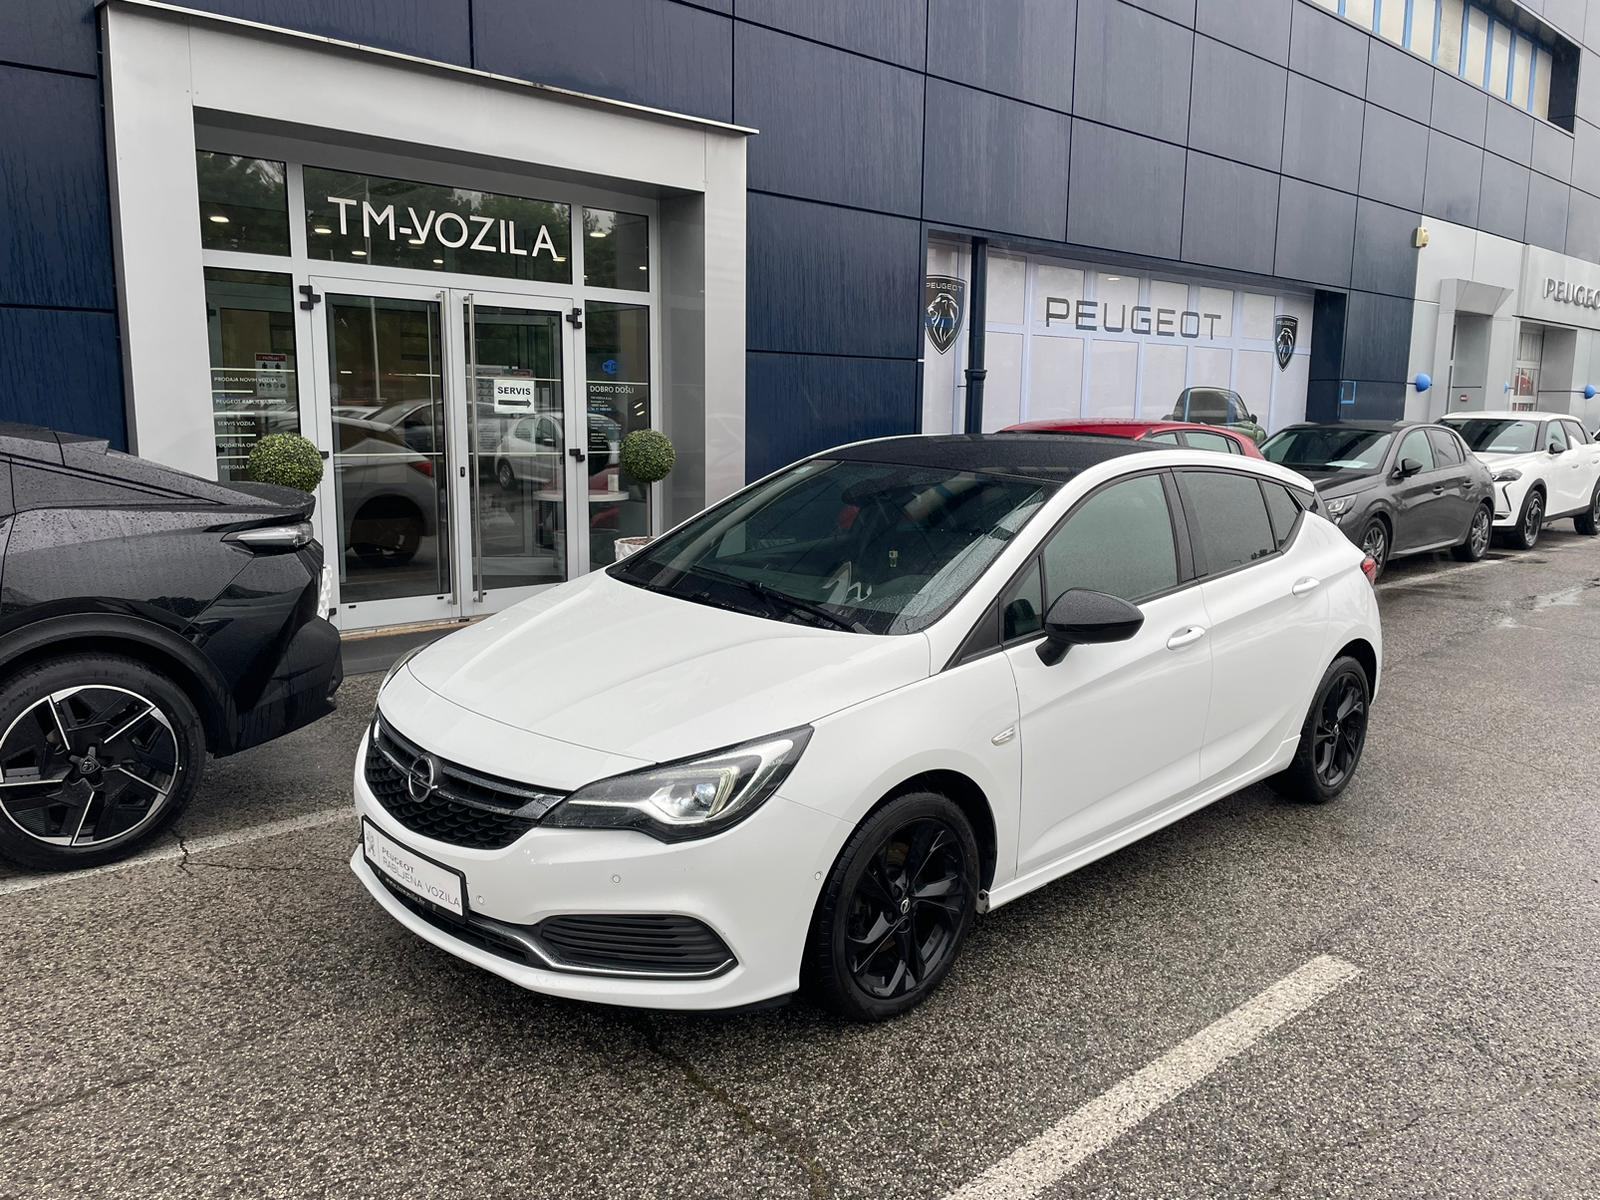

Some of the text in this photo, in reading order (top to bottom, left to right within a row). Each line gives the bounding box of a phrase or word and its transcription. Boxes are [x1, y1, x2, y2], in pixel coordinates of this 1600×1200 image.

[327, 196, 559, 260] TM-VOZILA
[926, 282, 963, 292] PEUGEOT
[1045, 296, 1222, 340] PEUGEOT
[497, 386, 531, 396] SERVIS
[589, 385, 635, 394] DOBRO DOŠLI
[381, 846, 415, 874] PEUGEOT
[382, 856, 424, 889] RABLJENA
[425, 881, 461, 908] VOZILA
